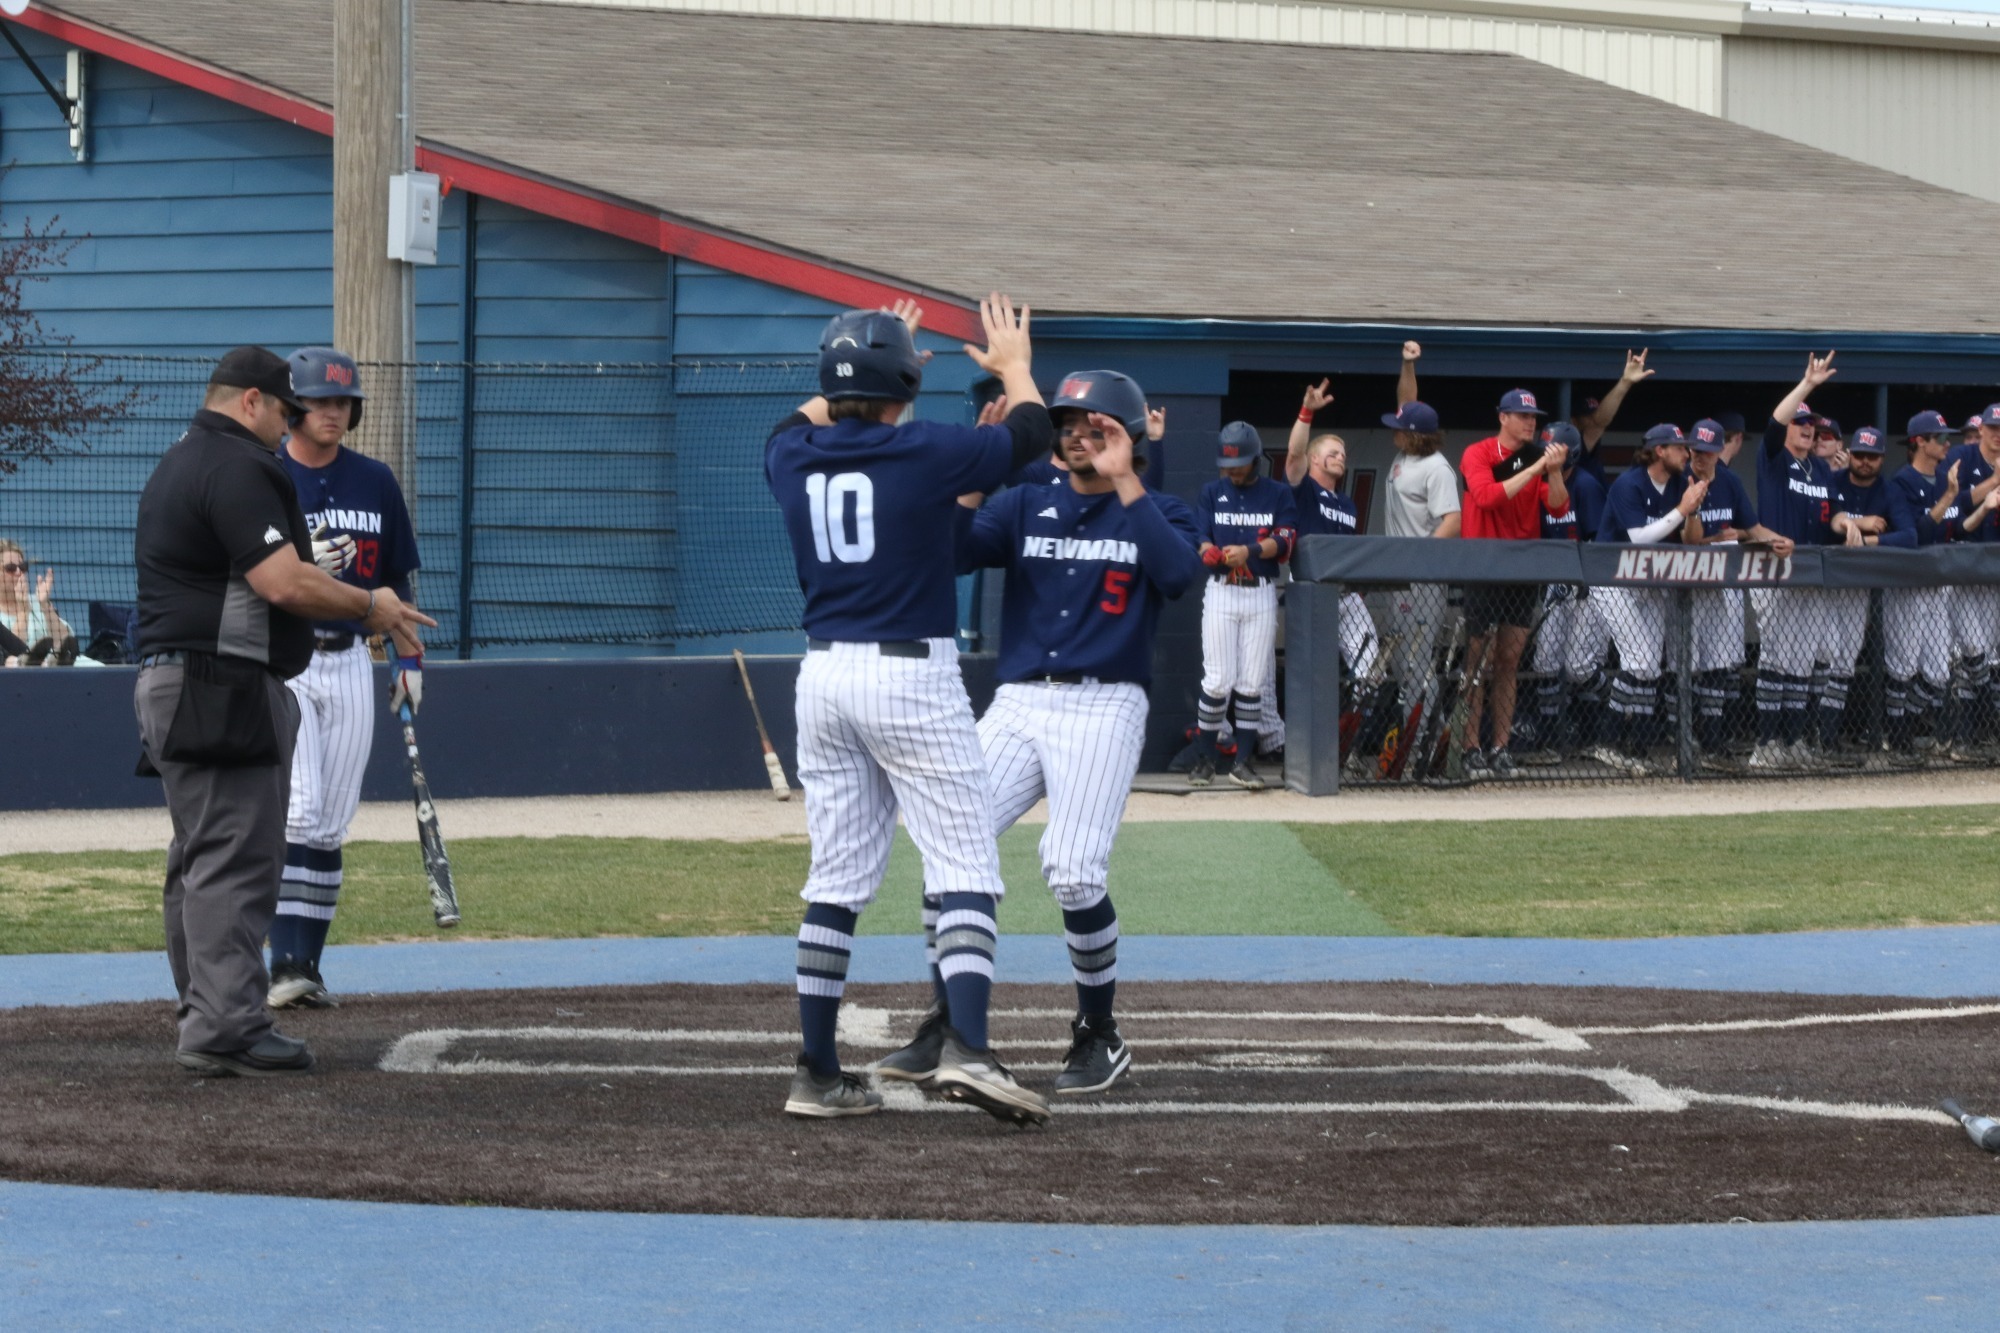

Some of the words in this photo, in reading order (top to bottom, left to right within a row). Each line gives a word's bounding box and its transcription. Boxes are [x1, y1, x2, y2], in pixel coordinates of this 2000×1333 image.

[326, 363, 352, 385] NU
[836, 362, 854, 377] 10
[305, 508, 381, 534] EWMAN
[805, 471, 876, 564] 10
[1214, 512, 1273, 526] NEWMAN
[356, 539, 380, 578] 13
[1022, 535, 1138, 565] NEWMAN
[1615, 549, 1727, 581] NEWMAN
[1100, 569, 1132, 616] 5
